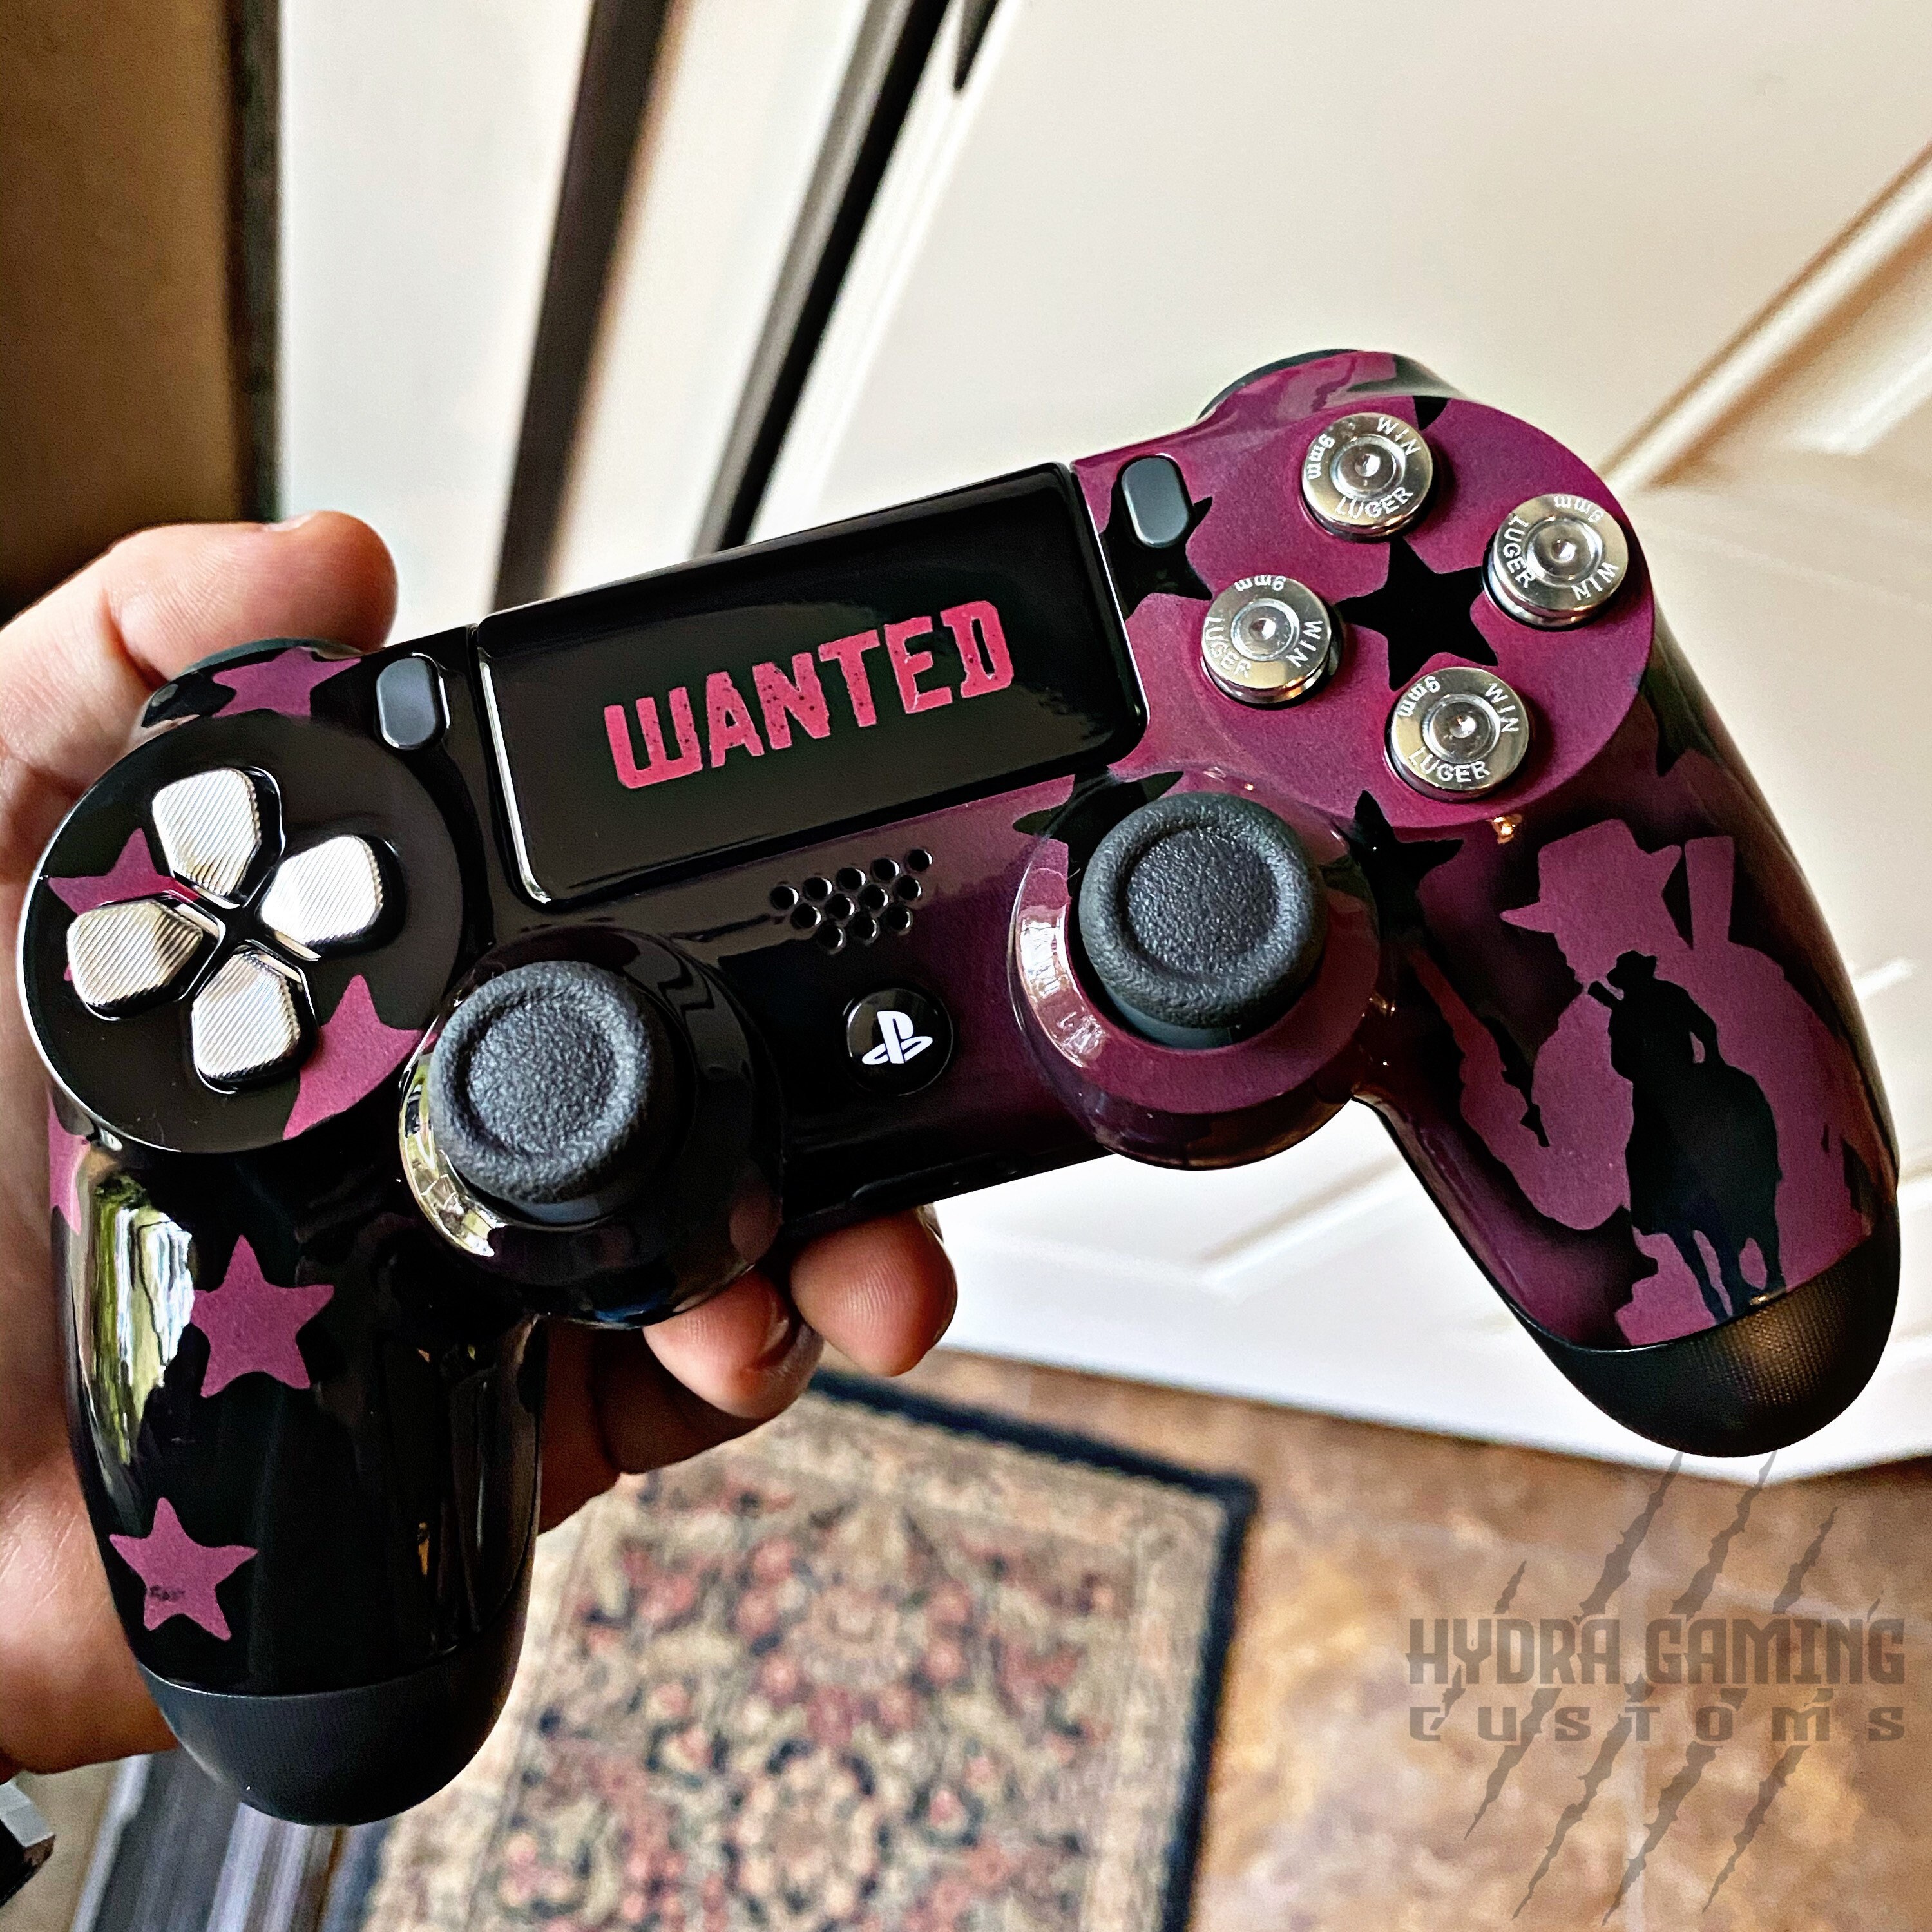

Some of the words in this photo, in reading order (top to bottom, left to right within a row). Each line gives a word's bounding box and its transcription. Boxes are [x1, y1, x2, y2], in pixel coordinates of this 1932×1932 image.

[1376, 416, 1421, 455] WIN
[1335, 486, 1413, 519] LUGER
[1503, 515, 1536, 589] LUGER
[1234, 574, 1286, 592] 9mm
[1571, 562, 1619, 600] WIN
[1204, 616, 1252, 678] LUGER
[1286, 620, 1323, 668] WIN
[604, 600, 1014, 789] WANTED
[1485, 683, 1519, 732] WIN
[1408, 746, 1491, 783] LUGER
